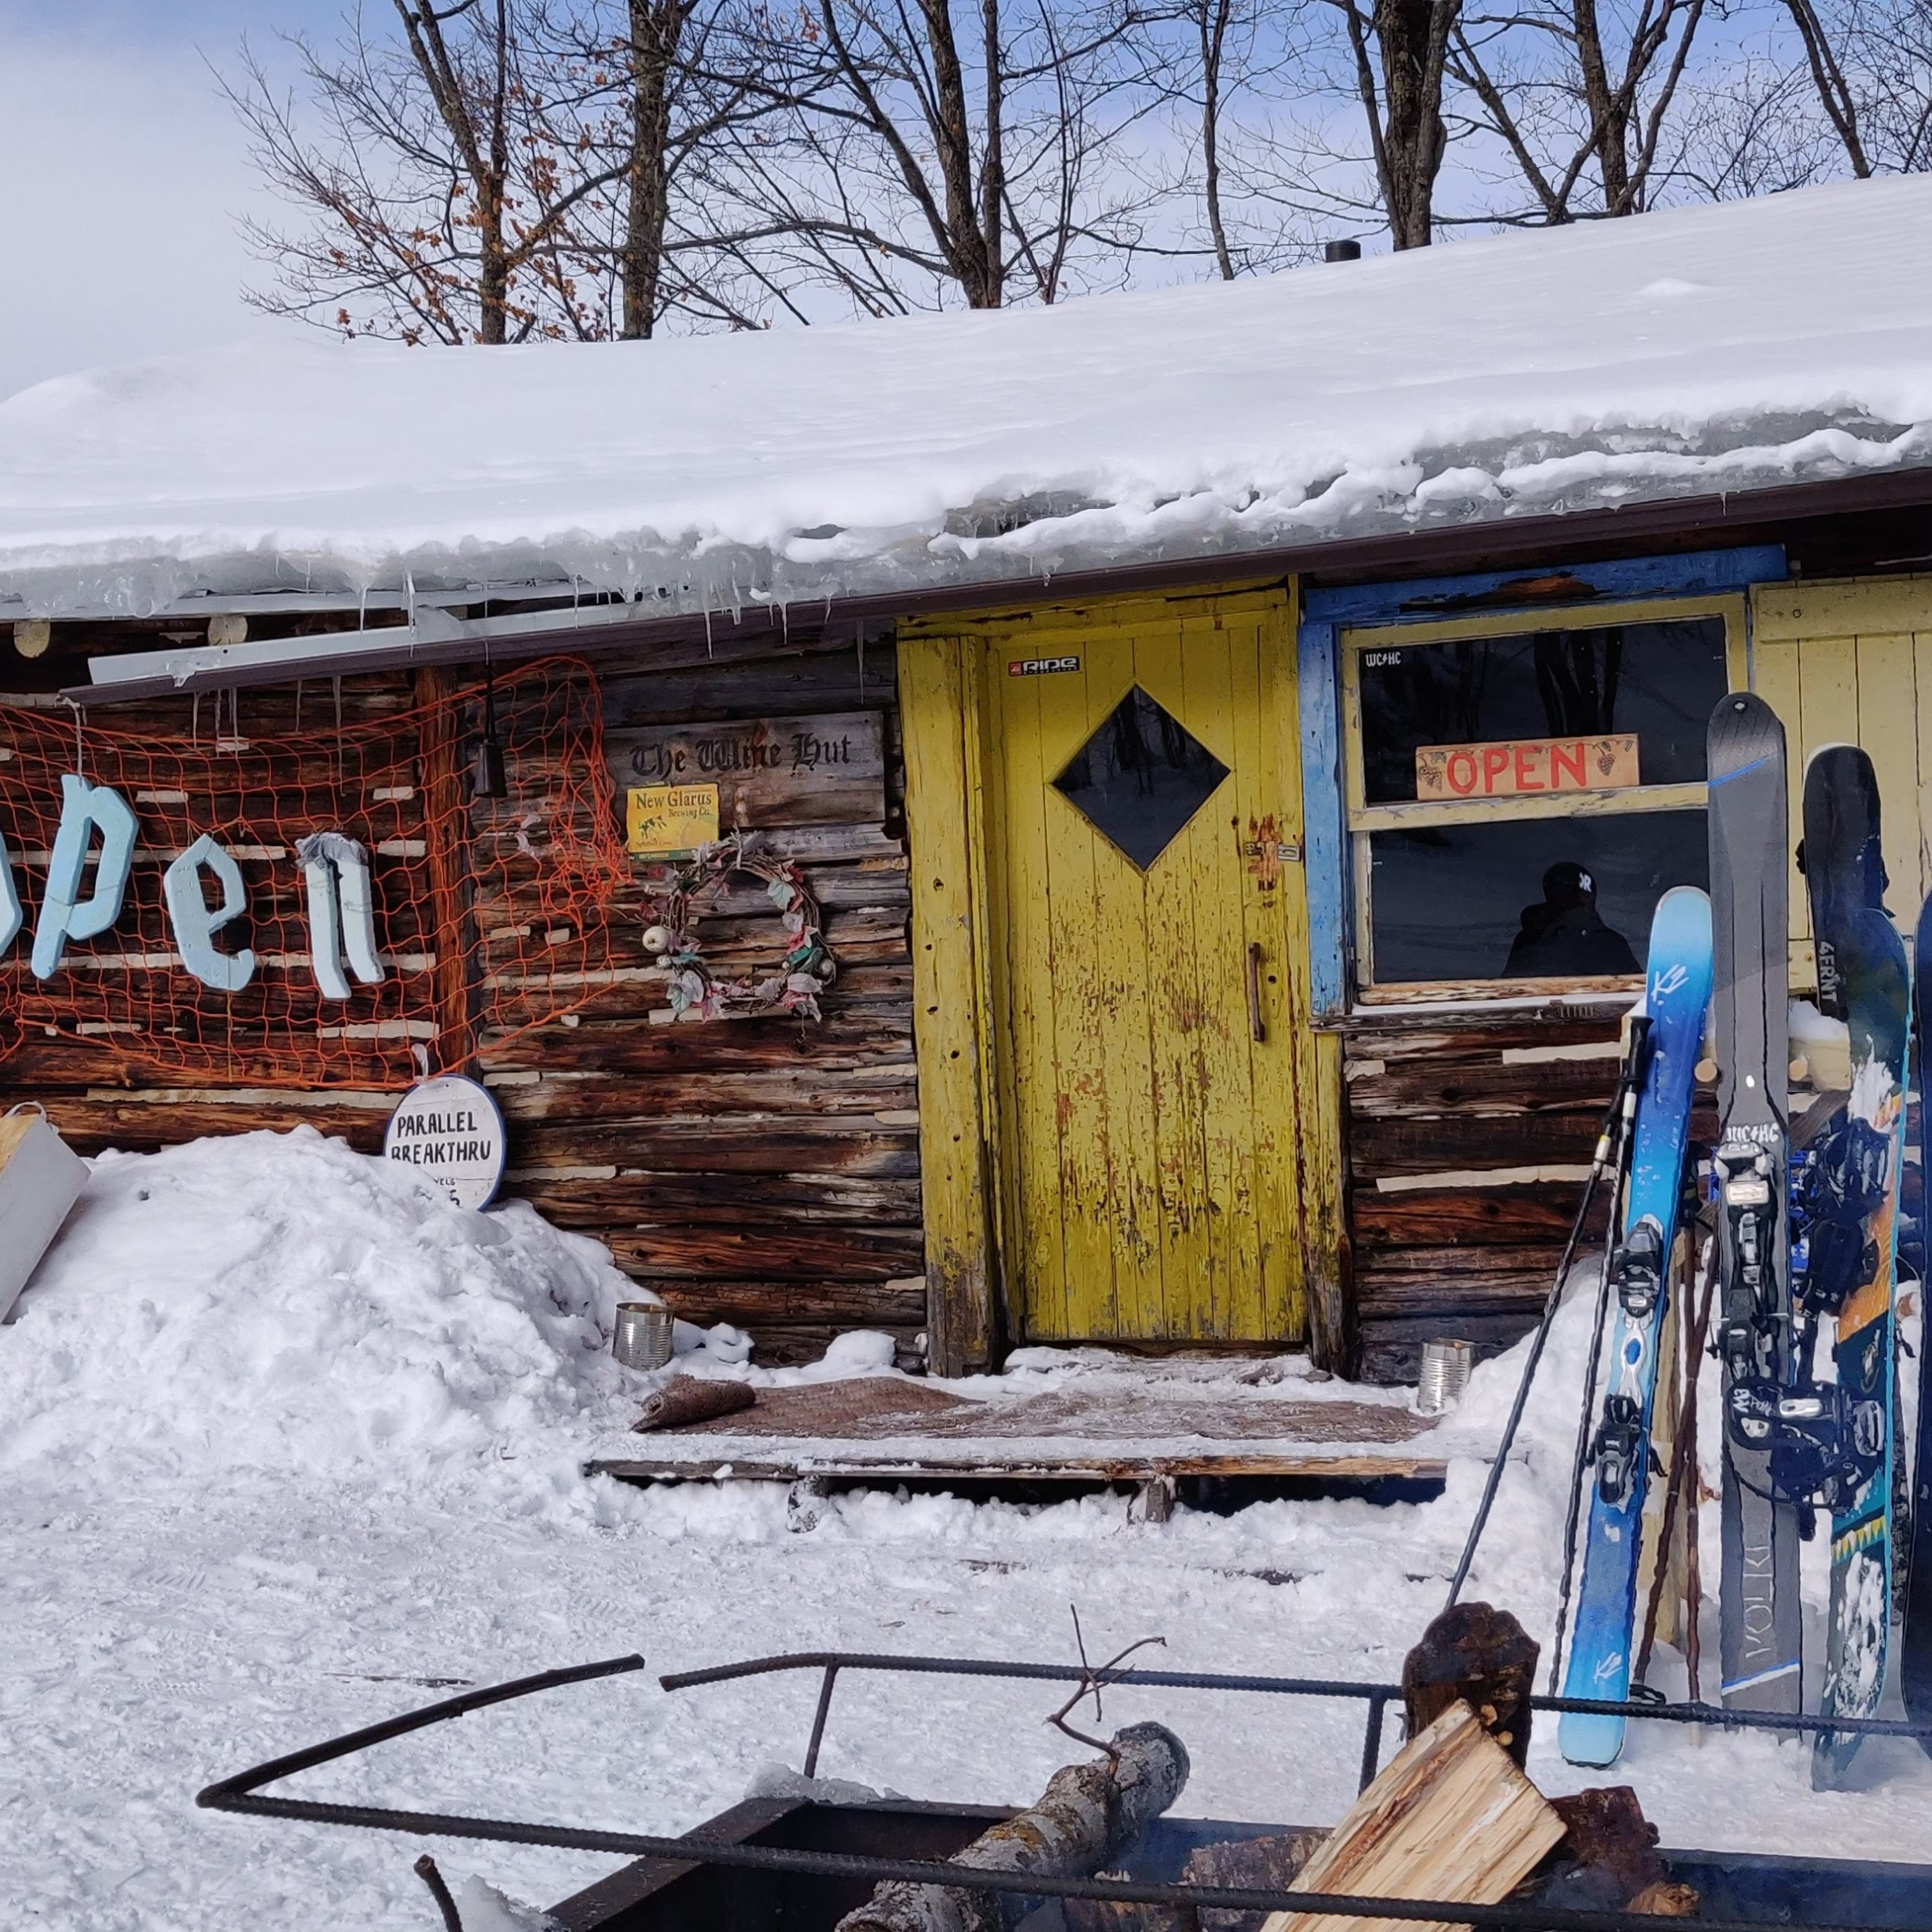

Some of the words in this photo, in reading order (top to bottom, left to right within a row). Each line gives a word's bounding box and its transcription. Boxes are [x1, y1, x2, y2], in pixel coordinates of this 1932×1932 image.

[1023, 657, 1077, 672] RIDE
[629, 742, 687, 781] The
[695, 736, 783, 772] Wine
[791, 732, 852, 772] Hut
[1446, 742, 1587, 795] OPEN
[635, 792, 665, 810] New
[667, 790, 712, 807] Glarus
[668, 808, 697, 819] Brewing
[1651, 963, 1690, 1002] K2
[1818, 940, 1838, 1002] 4FRNT
[396, 1111, 478, 1139] PARALLEL
[391, 1140, 491, 1165] BREAKTHRU
[1592, 1651, 1624, 1685] K2
